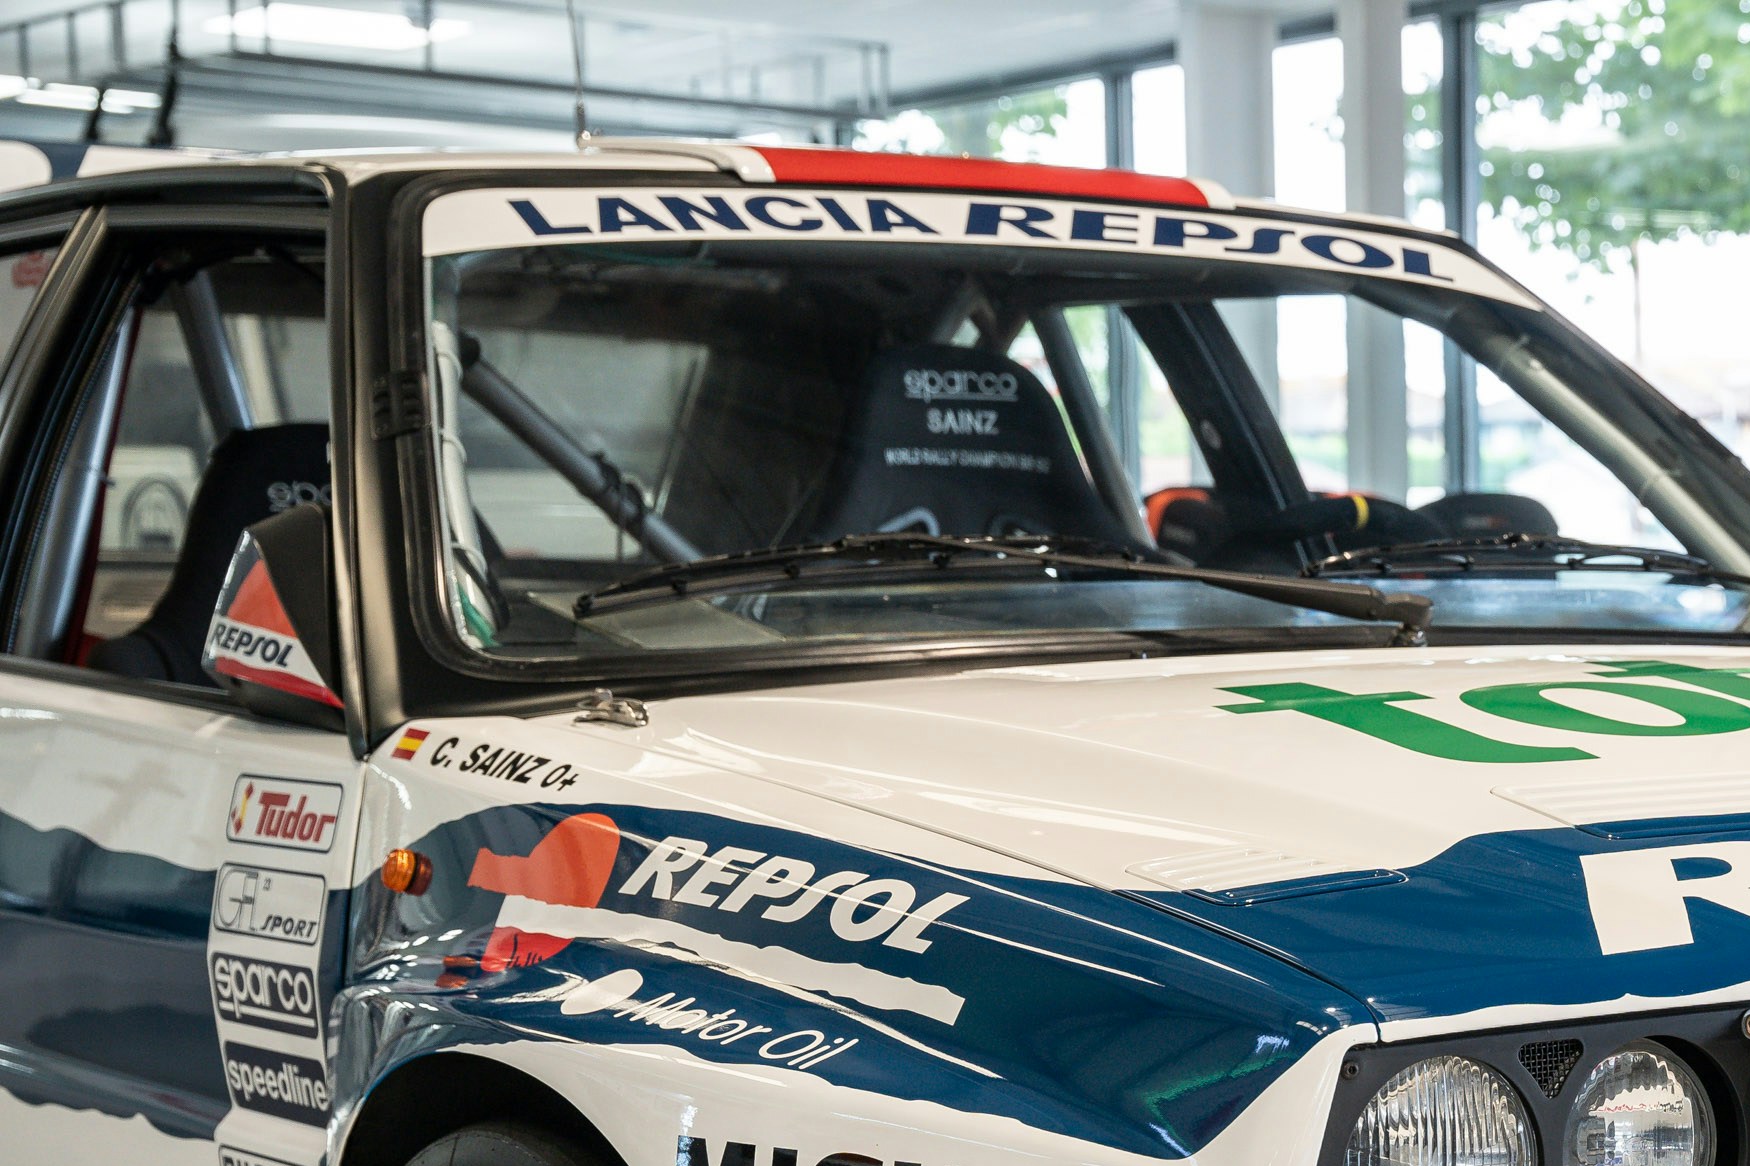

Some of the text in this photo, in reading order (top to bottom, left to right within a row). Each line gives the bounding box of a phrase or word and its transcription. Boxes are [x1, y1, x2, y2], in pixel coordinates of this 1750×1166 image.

[507, 195, 1455, 283] LANCIA REPSOL
[903, 369, 1019, 403] sparco
[926, 408, 1000, 435] SAINZ
[209, 623, 294, 668] REPSOL
[459, 744, 552, 784] SAINZ
[258, 791, 337, 843] Tudor
[618, 835, 971, 955] REPSOL
[260, 913, 317, 938] SPORT
[214, 956, 314, 1020] sparco
[613, 991, 859, 1070] Motor Oil
[227, 1058, 329, 1112] speedline
